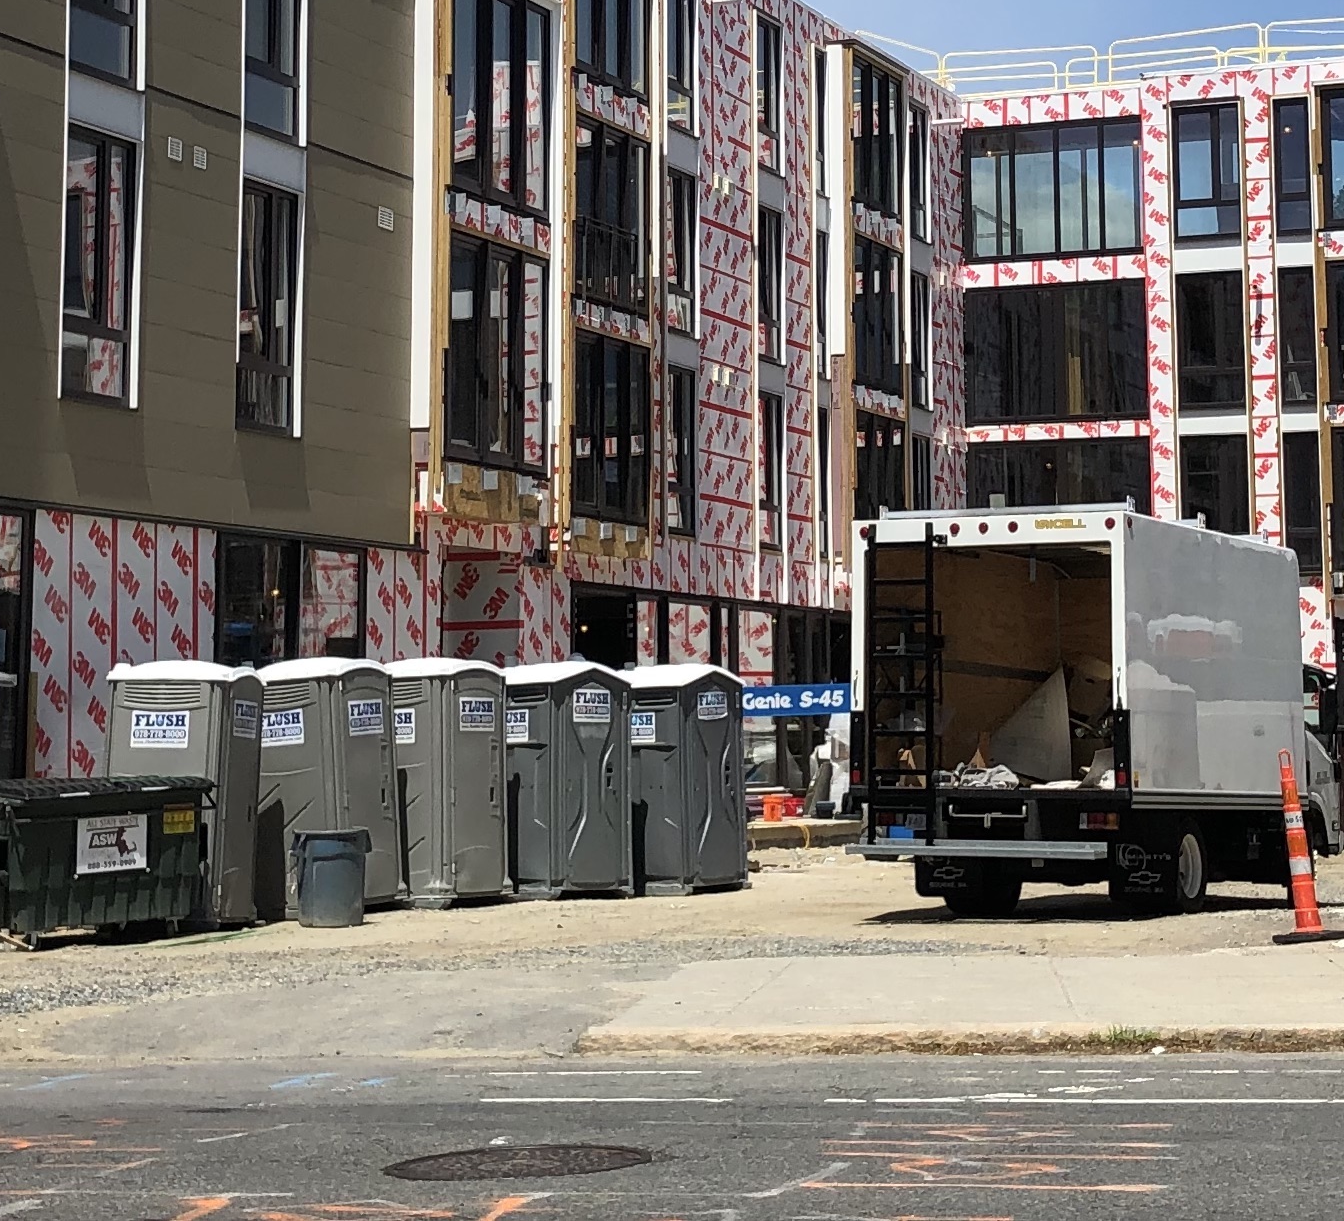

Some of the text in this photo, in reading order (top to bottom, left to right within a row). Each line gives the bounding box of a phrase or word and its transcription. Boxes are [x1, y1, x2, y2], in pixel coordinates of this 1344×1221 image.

[576, 692, 609, 704] FLUSH
[742, 690, 844, 710] Genie S-45
[350, 702, 382, 716] FLUSH
[461, 701, 493, 712] FLUSH
[134, 714, 187, 727] FLUSH
[92, 832, 118, 847] ASW
